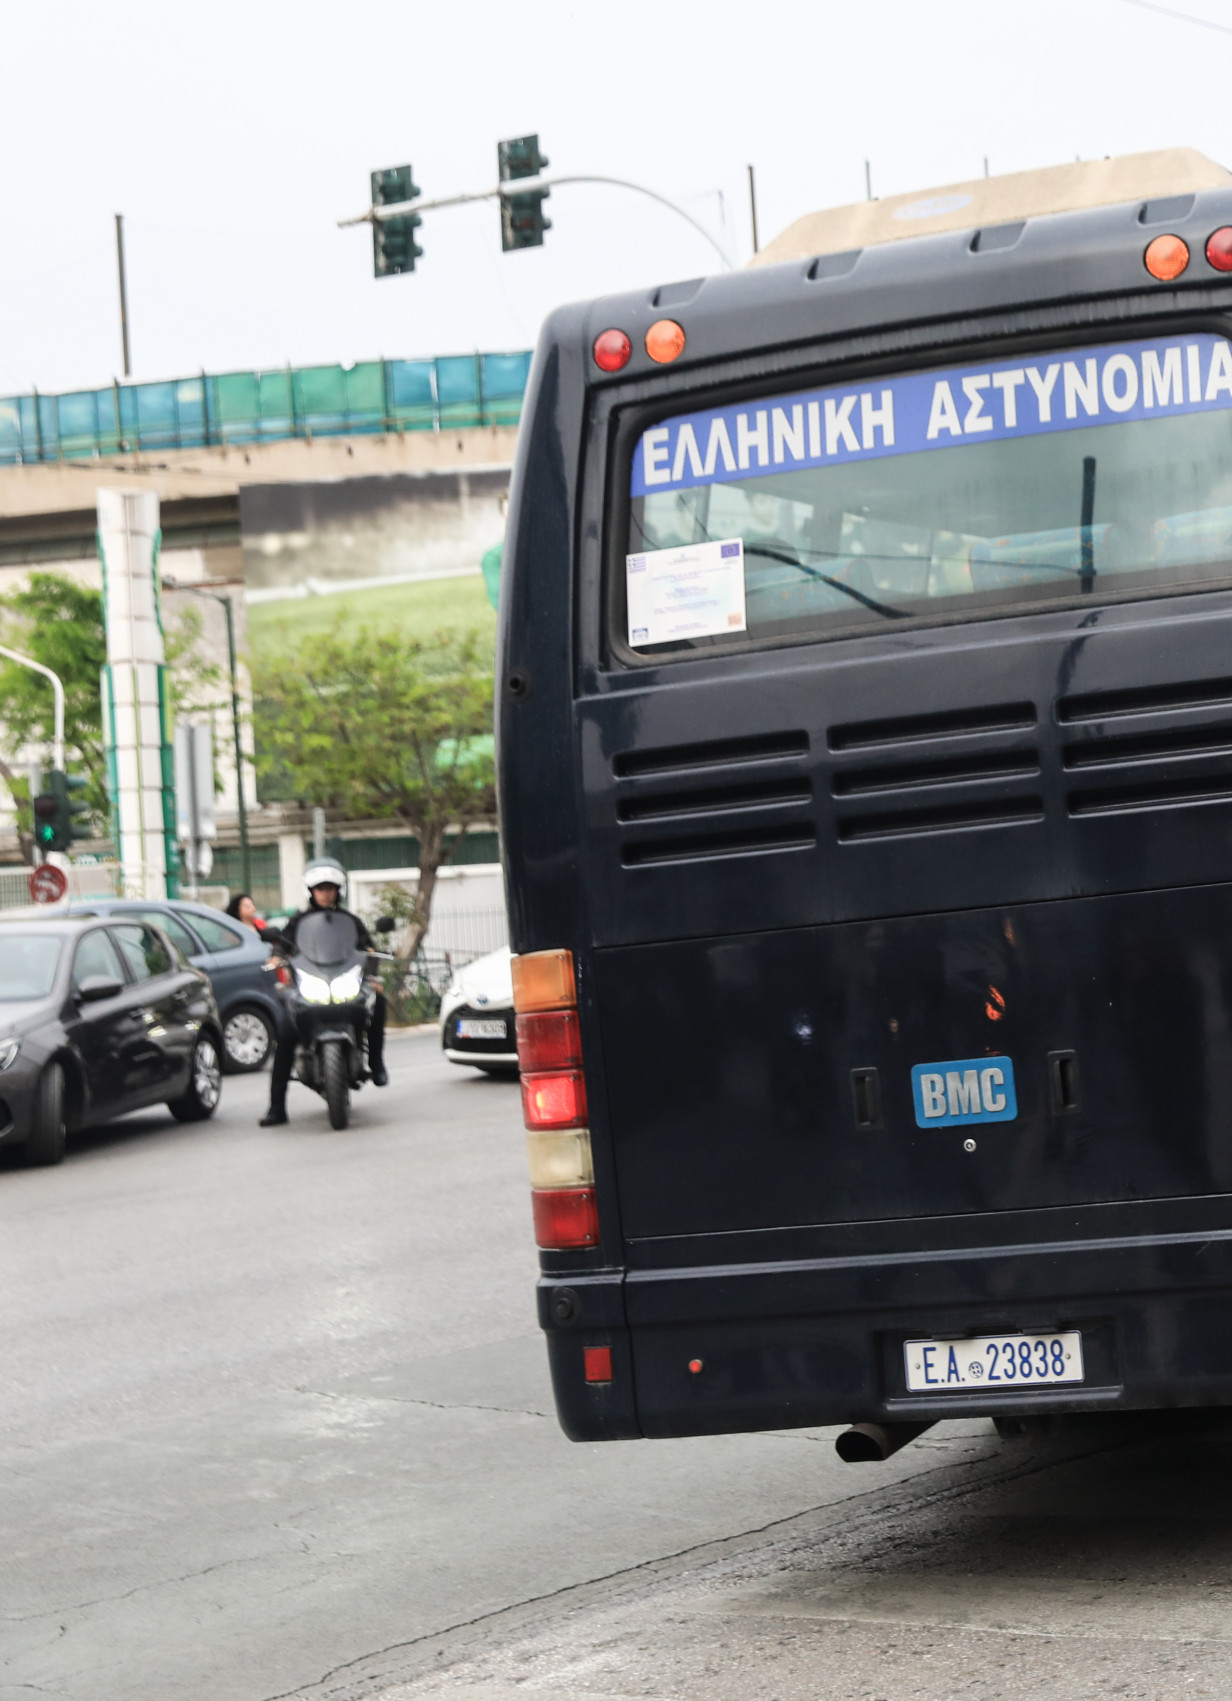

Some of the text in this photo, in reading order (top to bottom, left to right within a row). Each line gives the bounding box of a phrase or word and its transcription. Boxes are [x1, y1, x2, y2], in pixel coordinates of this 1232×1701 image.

[642, 389, 895, 486] ΕΛΛΗΝΙΚΗ
[920, 1067, 1007, 1118] BMC
[986, 1339, 1065, 1381] 23838
